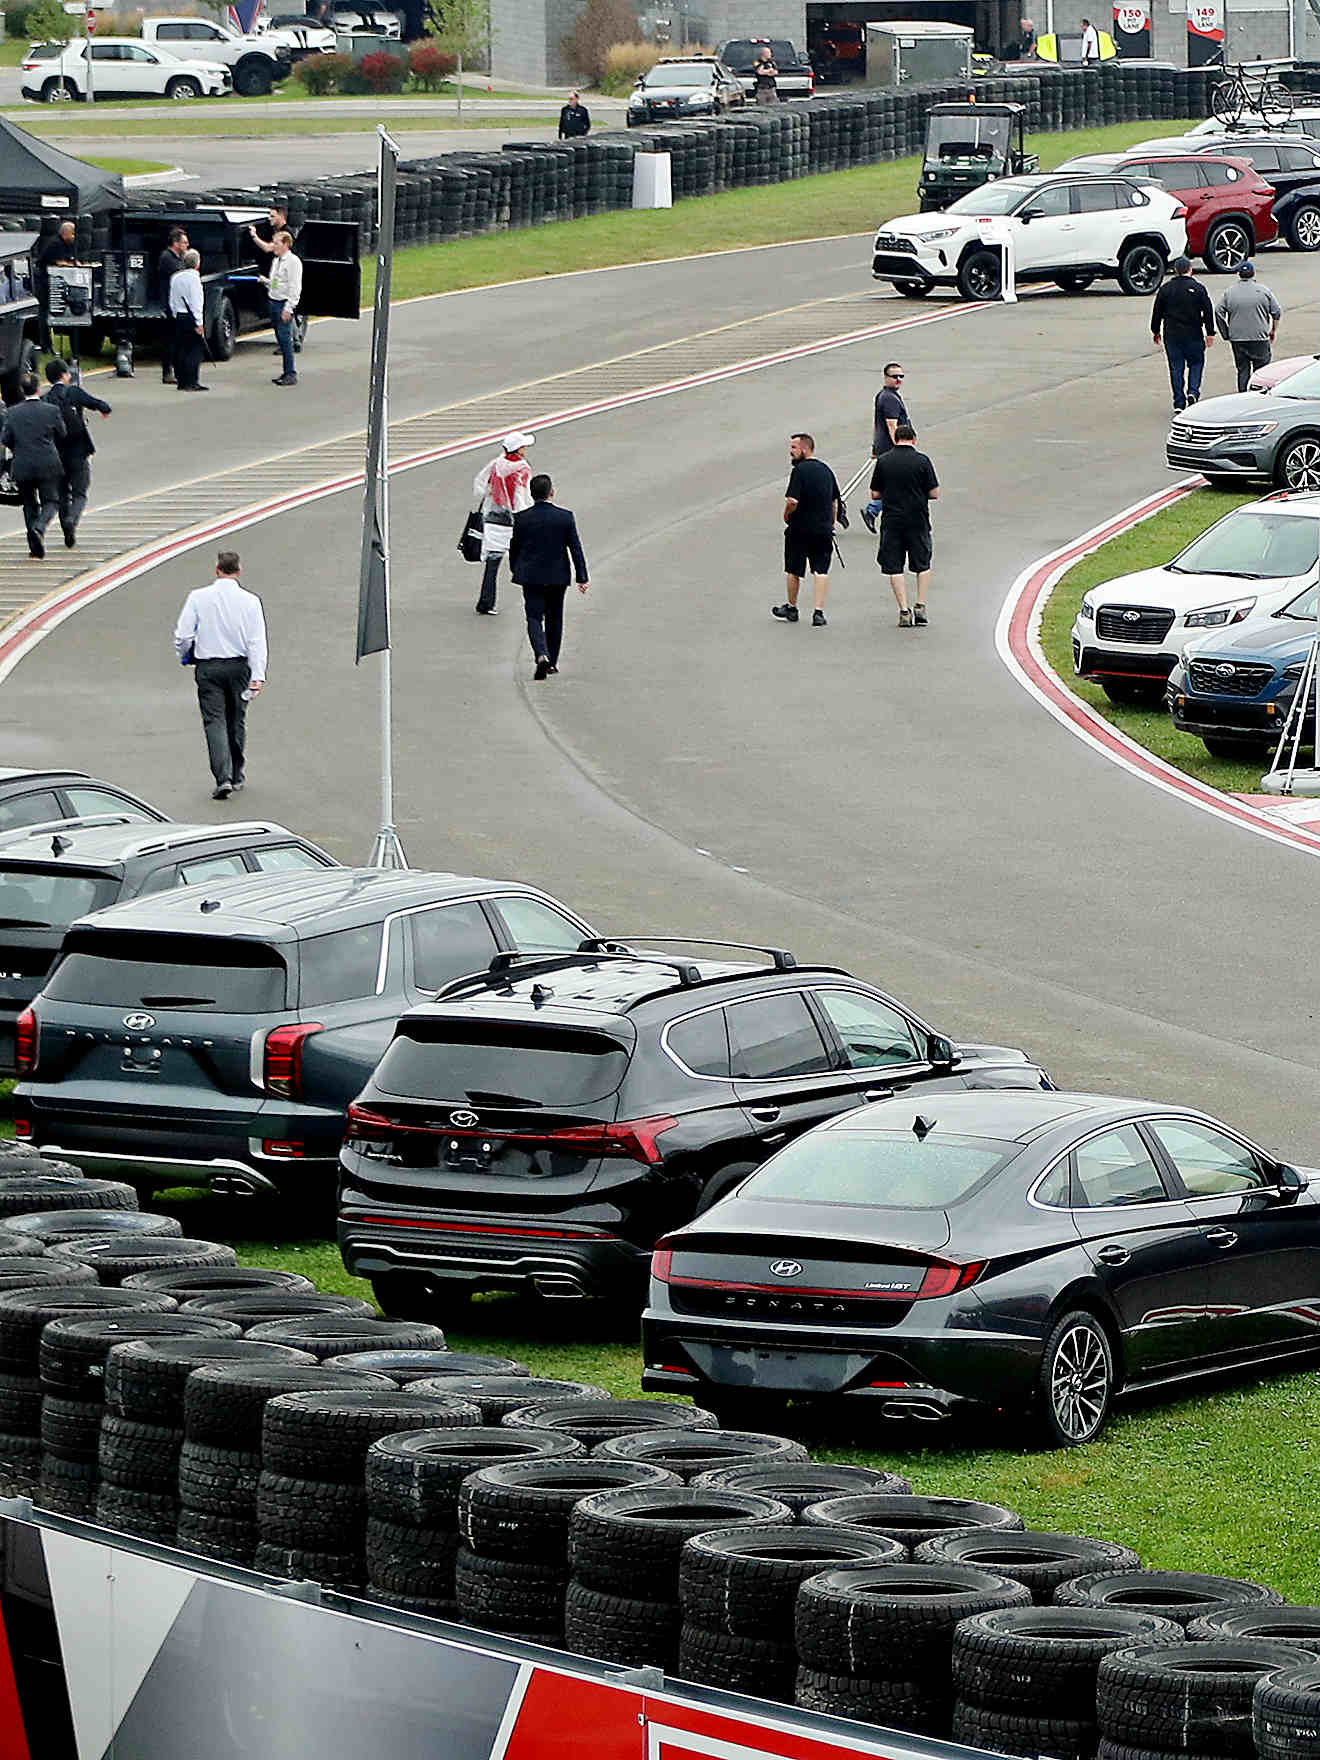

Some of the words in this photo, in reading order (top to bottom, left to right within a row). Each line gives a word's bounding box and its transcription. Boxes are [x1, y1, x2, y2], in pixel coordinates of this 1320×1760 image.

[1122, 9, 1142, 18] 150
[1196, 8, 1215, 17] 149
[725, 1296, 846, 1312] SONATA
